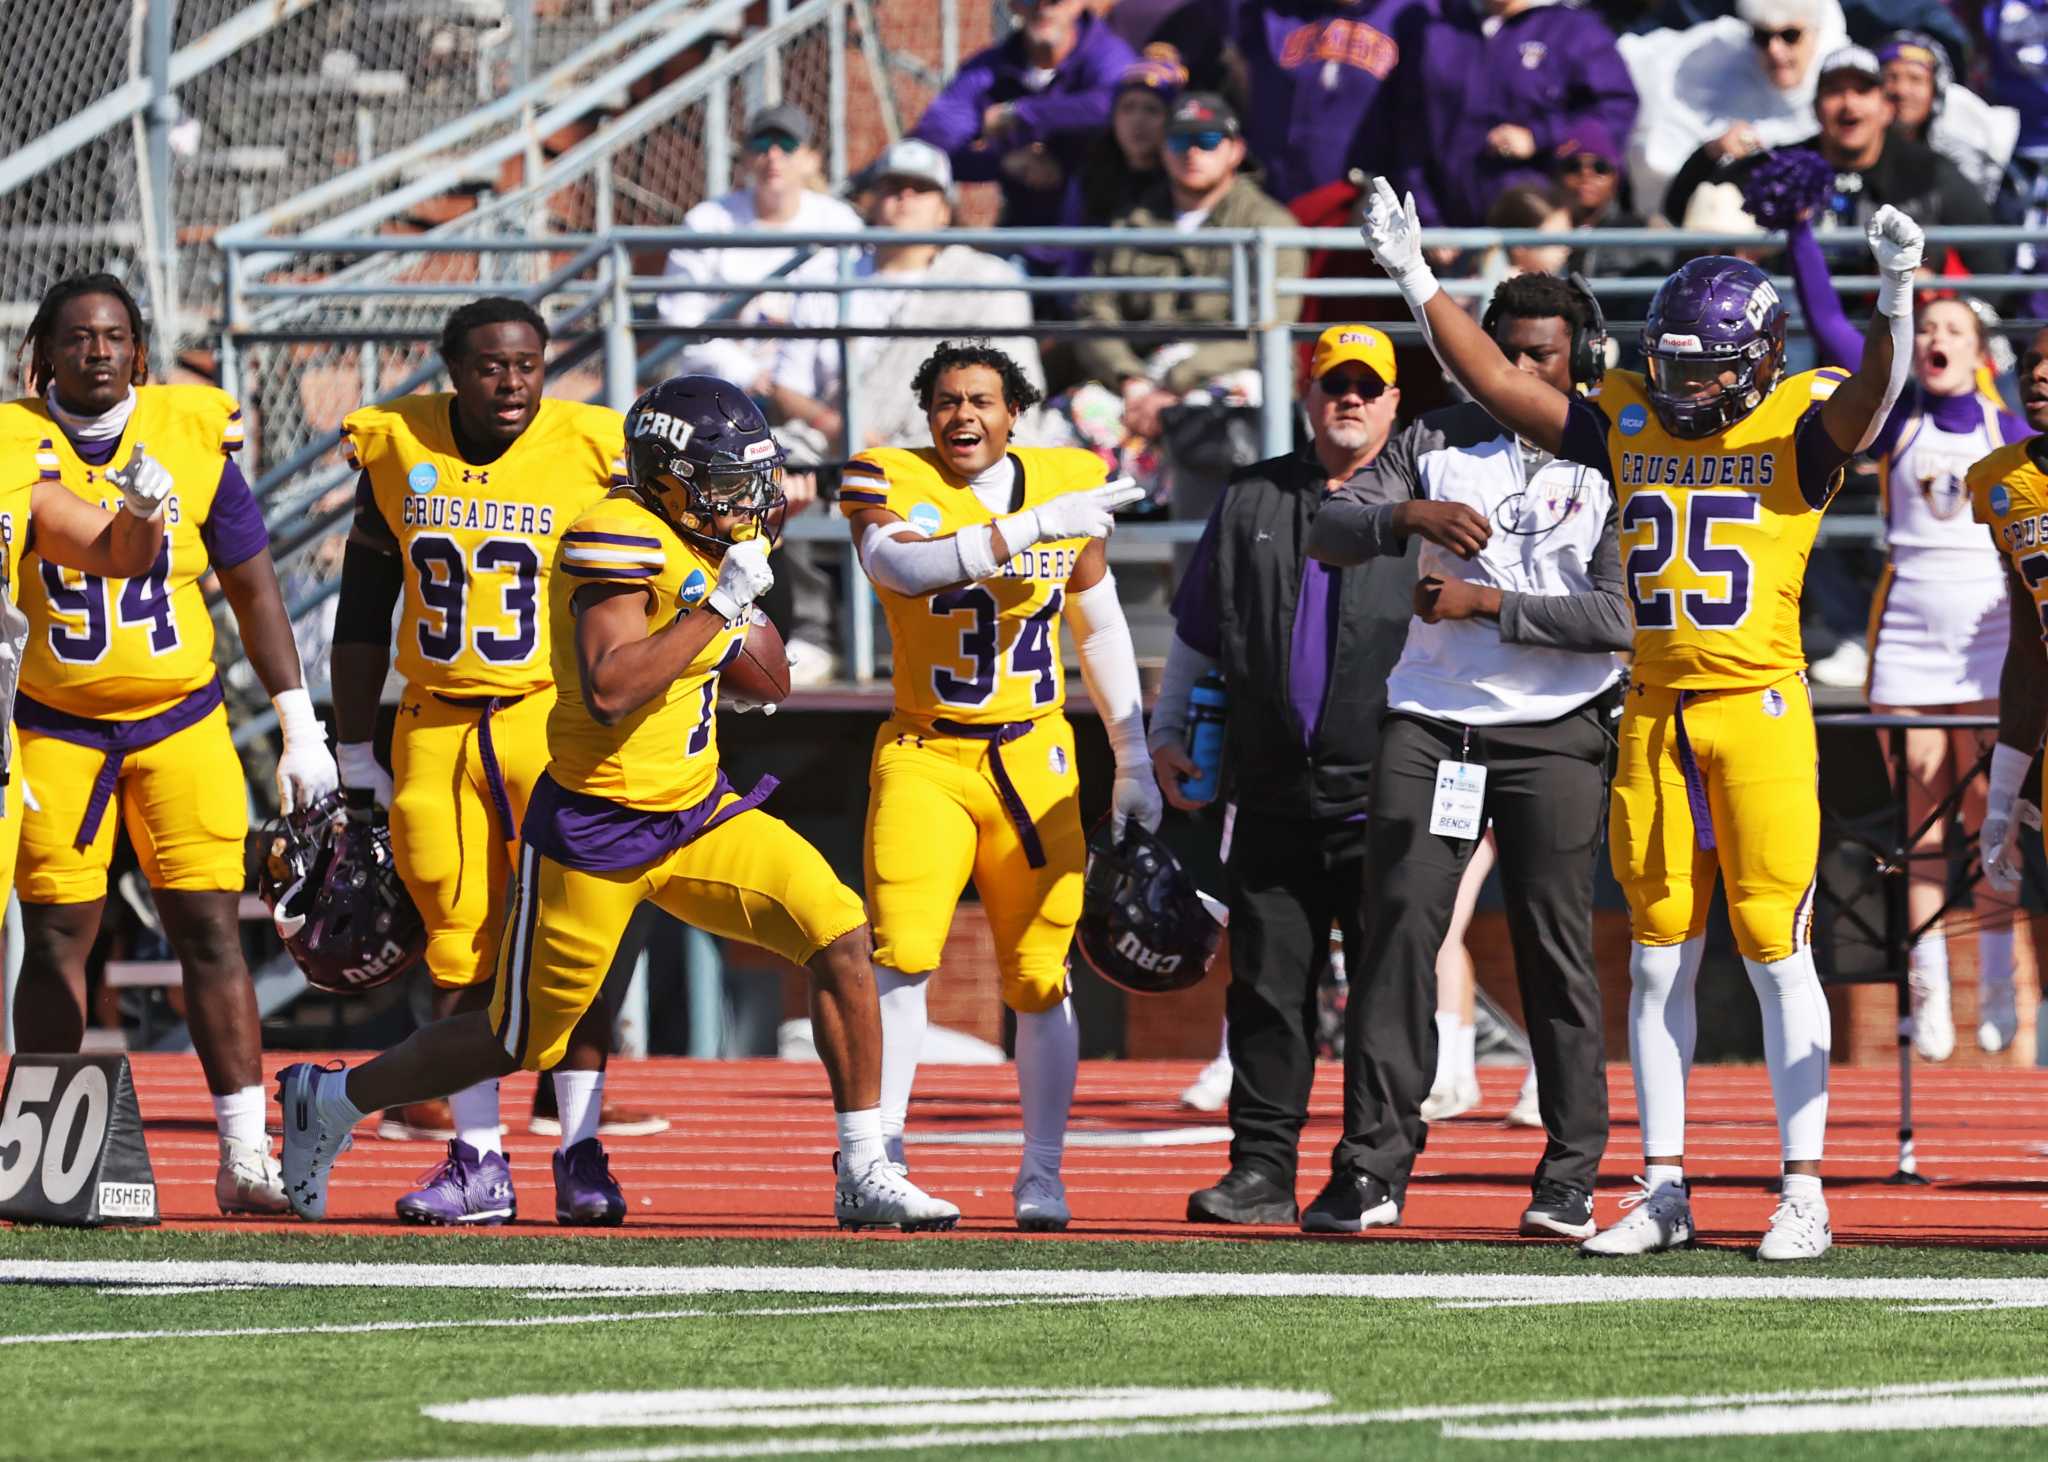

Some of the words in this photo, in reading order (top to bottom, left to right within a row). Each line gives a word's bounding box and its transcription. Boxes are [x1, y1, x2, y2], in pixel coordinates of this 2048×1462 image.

[1745, 281, 1780, 331] CRU
[634, 412, 696, 451] CRU
[1621, 451, 1776, 486] CRUSADERS
[403, 496, 553, 536] CRUSADERS
[1621, 489, 1761, 630] 25
[38, 532, 182, 665] 94
[409, 531, 543, 665] 93
[929, 583, 1065, 709] 34
[1439, 816, 1472, 830] BENCH
[341, 940, 403, 983] CRU
[1116, 931, 1182, 974] CRU
[0, 1064, 108, 1205] 50
[102, 1187, 151, 1206] FISHER
